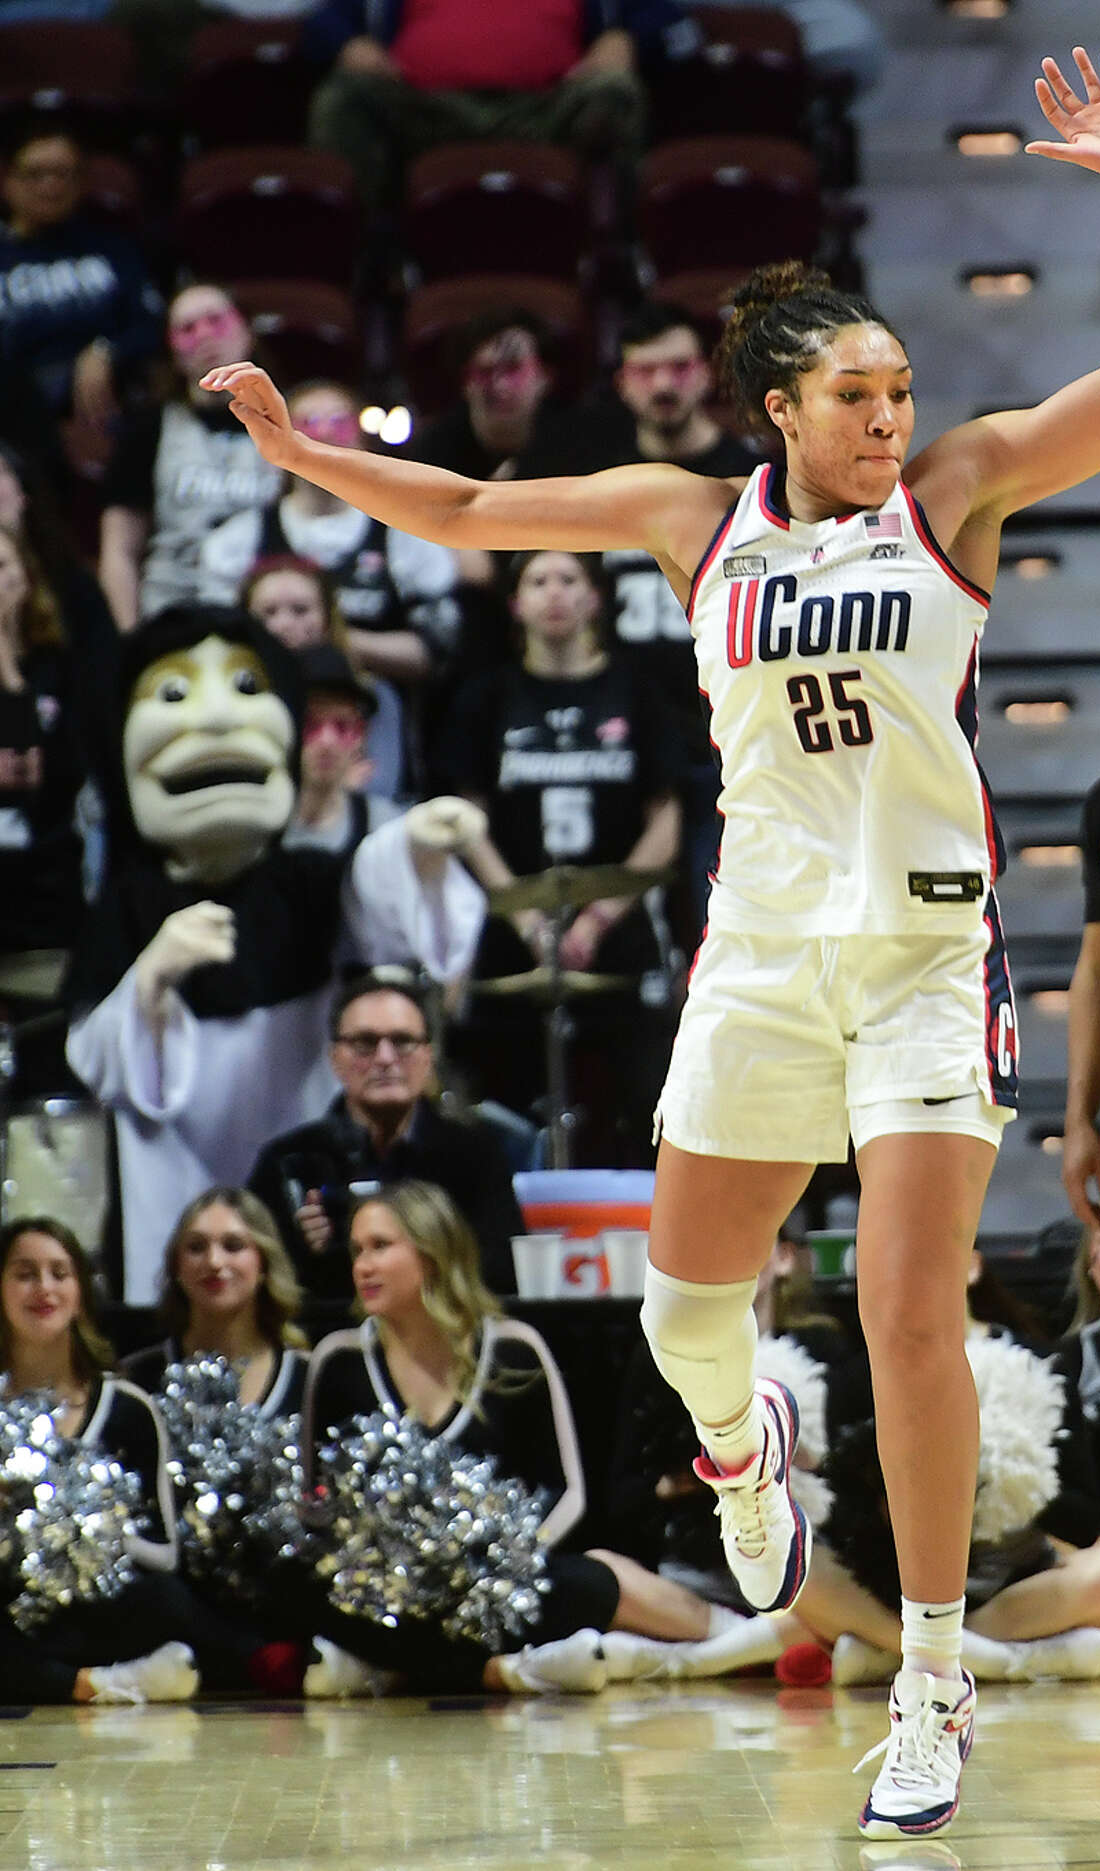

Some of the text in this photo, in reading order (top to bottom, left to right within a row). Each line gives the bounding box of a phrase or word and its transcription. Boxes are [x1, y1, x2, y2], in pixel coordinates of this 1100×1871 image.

[727, 574, 912, 669] UConn
[786, 670, 875, 754] 25
[997, 1001, 1014, 1078] C
